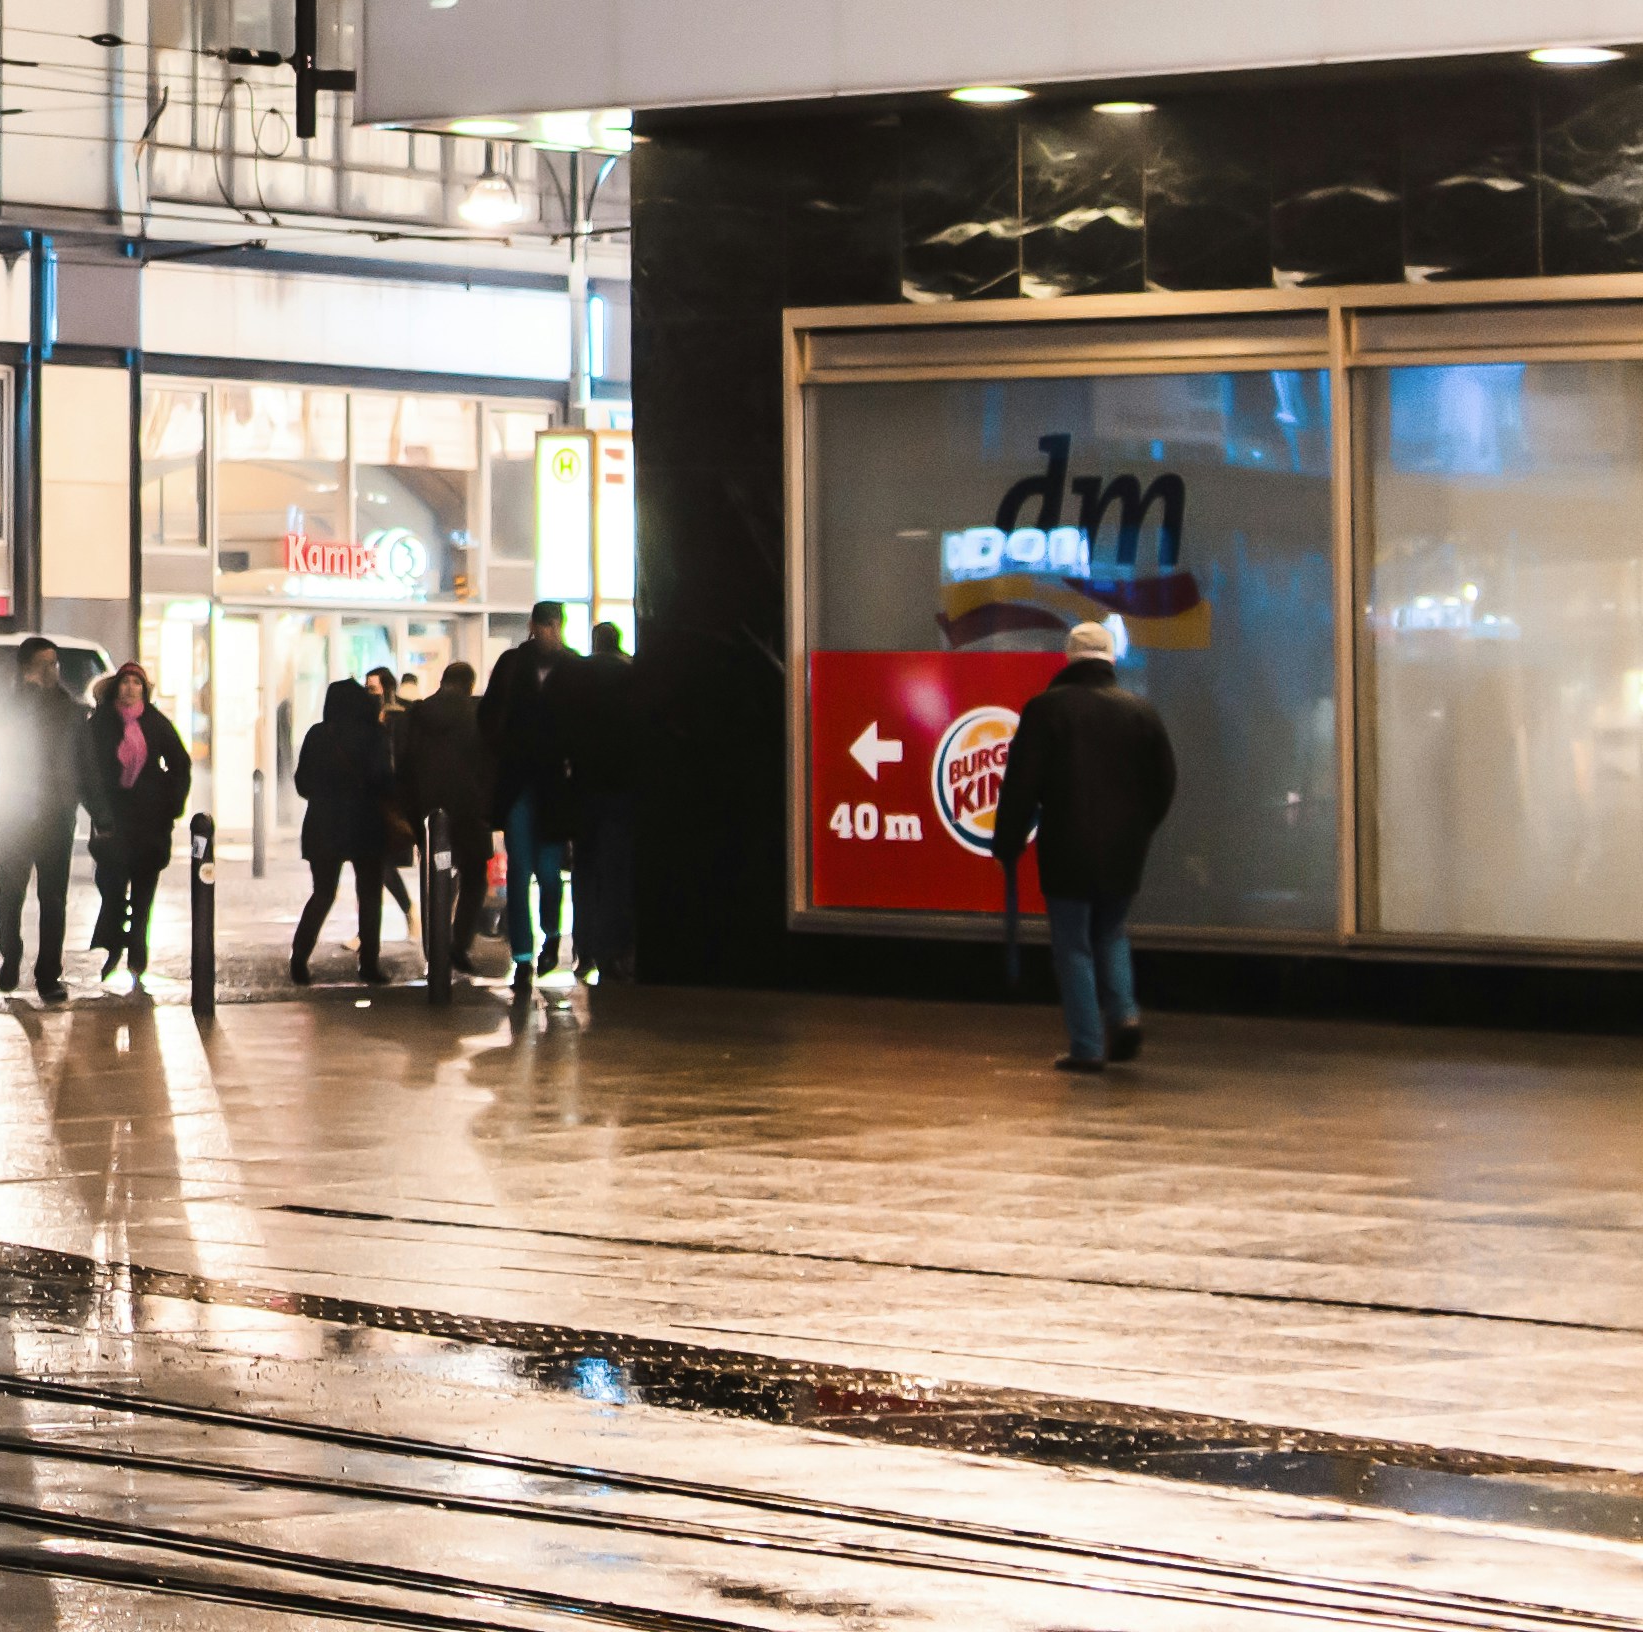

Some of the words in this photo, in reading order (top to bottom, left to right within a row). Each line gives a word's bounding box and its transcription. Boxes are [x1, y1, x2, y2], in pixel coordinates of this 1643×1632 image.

[995, 432, 1187, 567] dm
[948, 741, 1011, 787] BURG
[829, 801, 879, 840] 40
[884, 812, 923, 842] m
